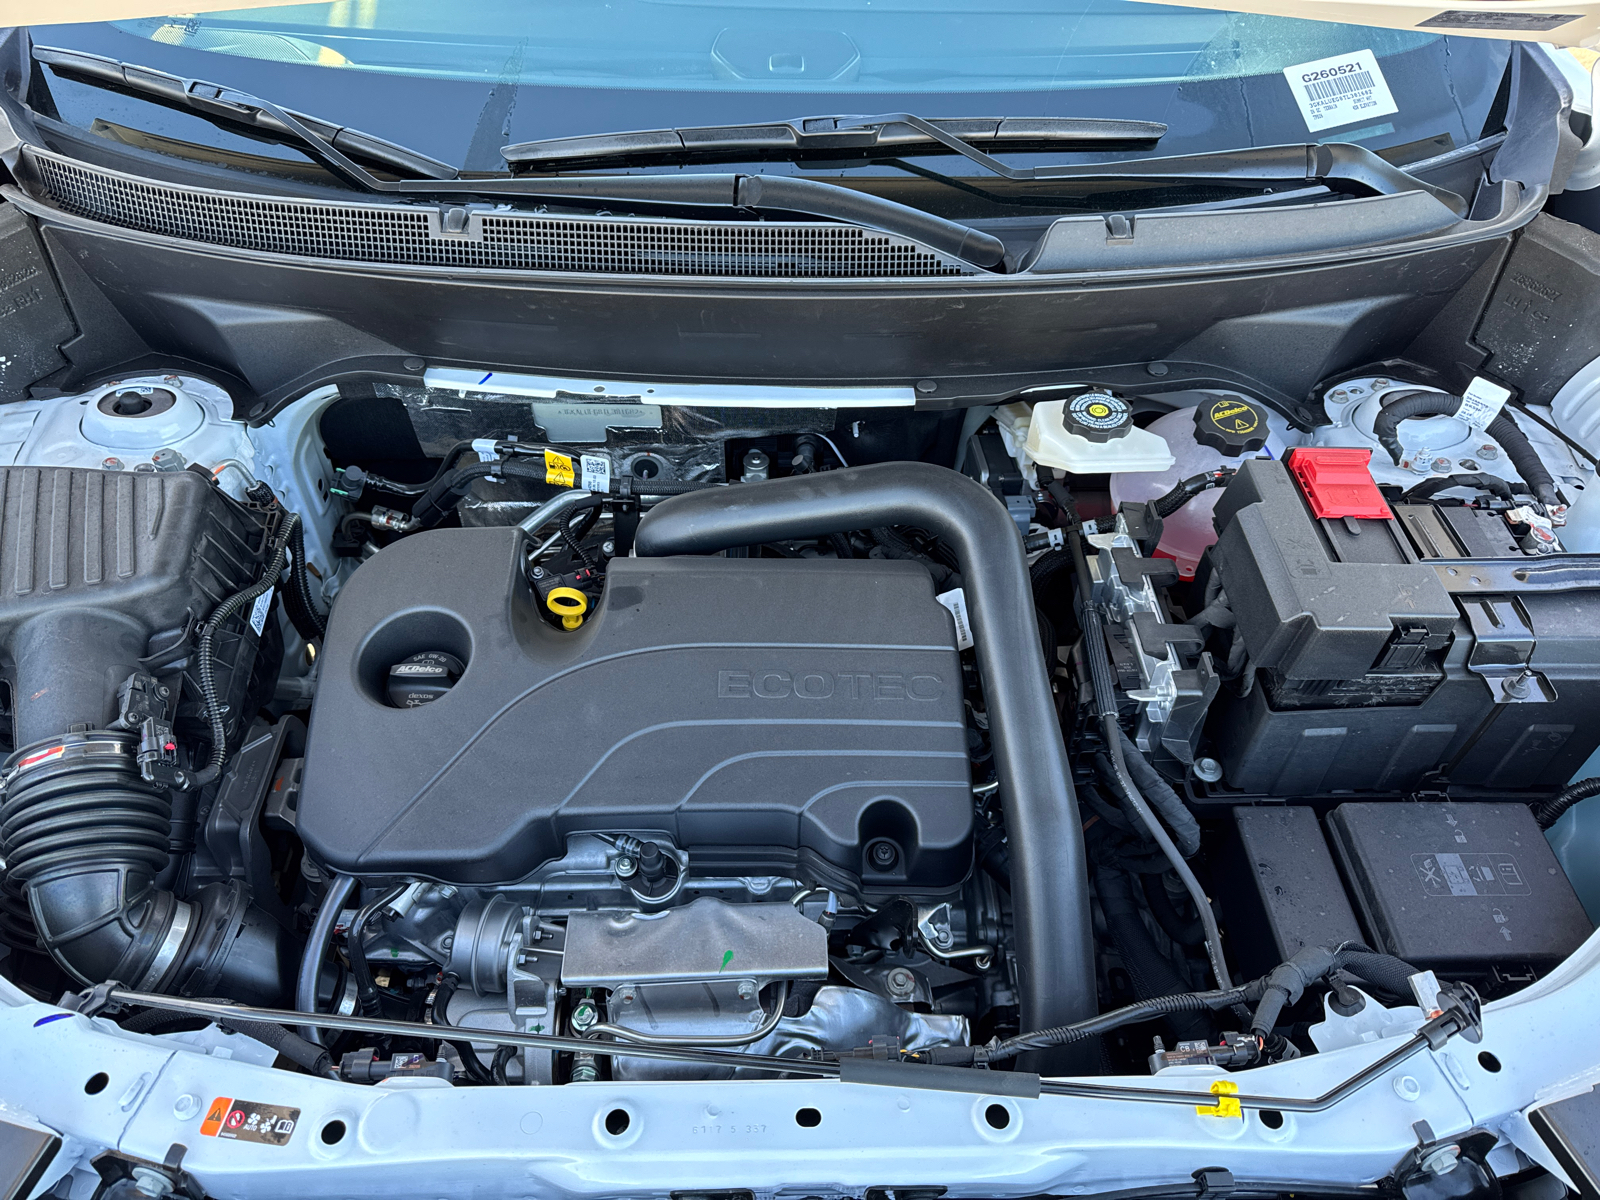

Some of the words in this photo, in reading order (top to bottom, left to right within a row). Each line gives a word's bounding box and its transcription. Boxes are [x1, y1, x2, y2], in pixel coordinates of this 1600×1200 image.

[1301, 61, 1363, 83] G260521
[1213, 405, 1249, 419] ACDelco
[413, 653, 426, 662] SAE
[428, 653, 447, 663] 0W-20
[395, 665, 443, 673] ACDelco
[718, 669, 943, 700] ECOTEC
[1180, 1045, 1190, 1053] CB
[243, 1123, 258, 1131] AUTO
[730, 1125, 736, 1134] 5
